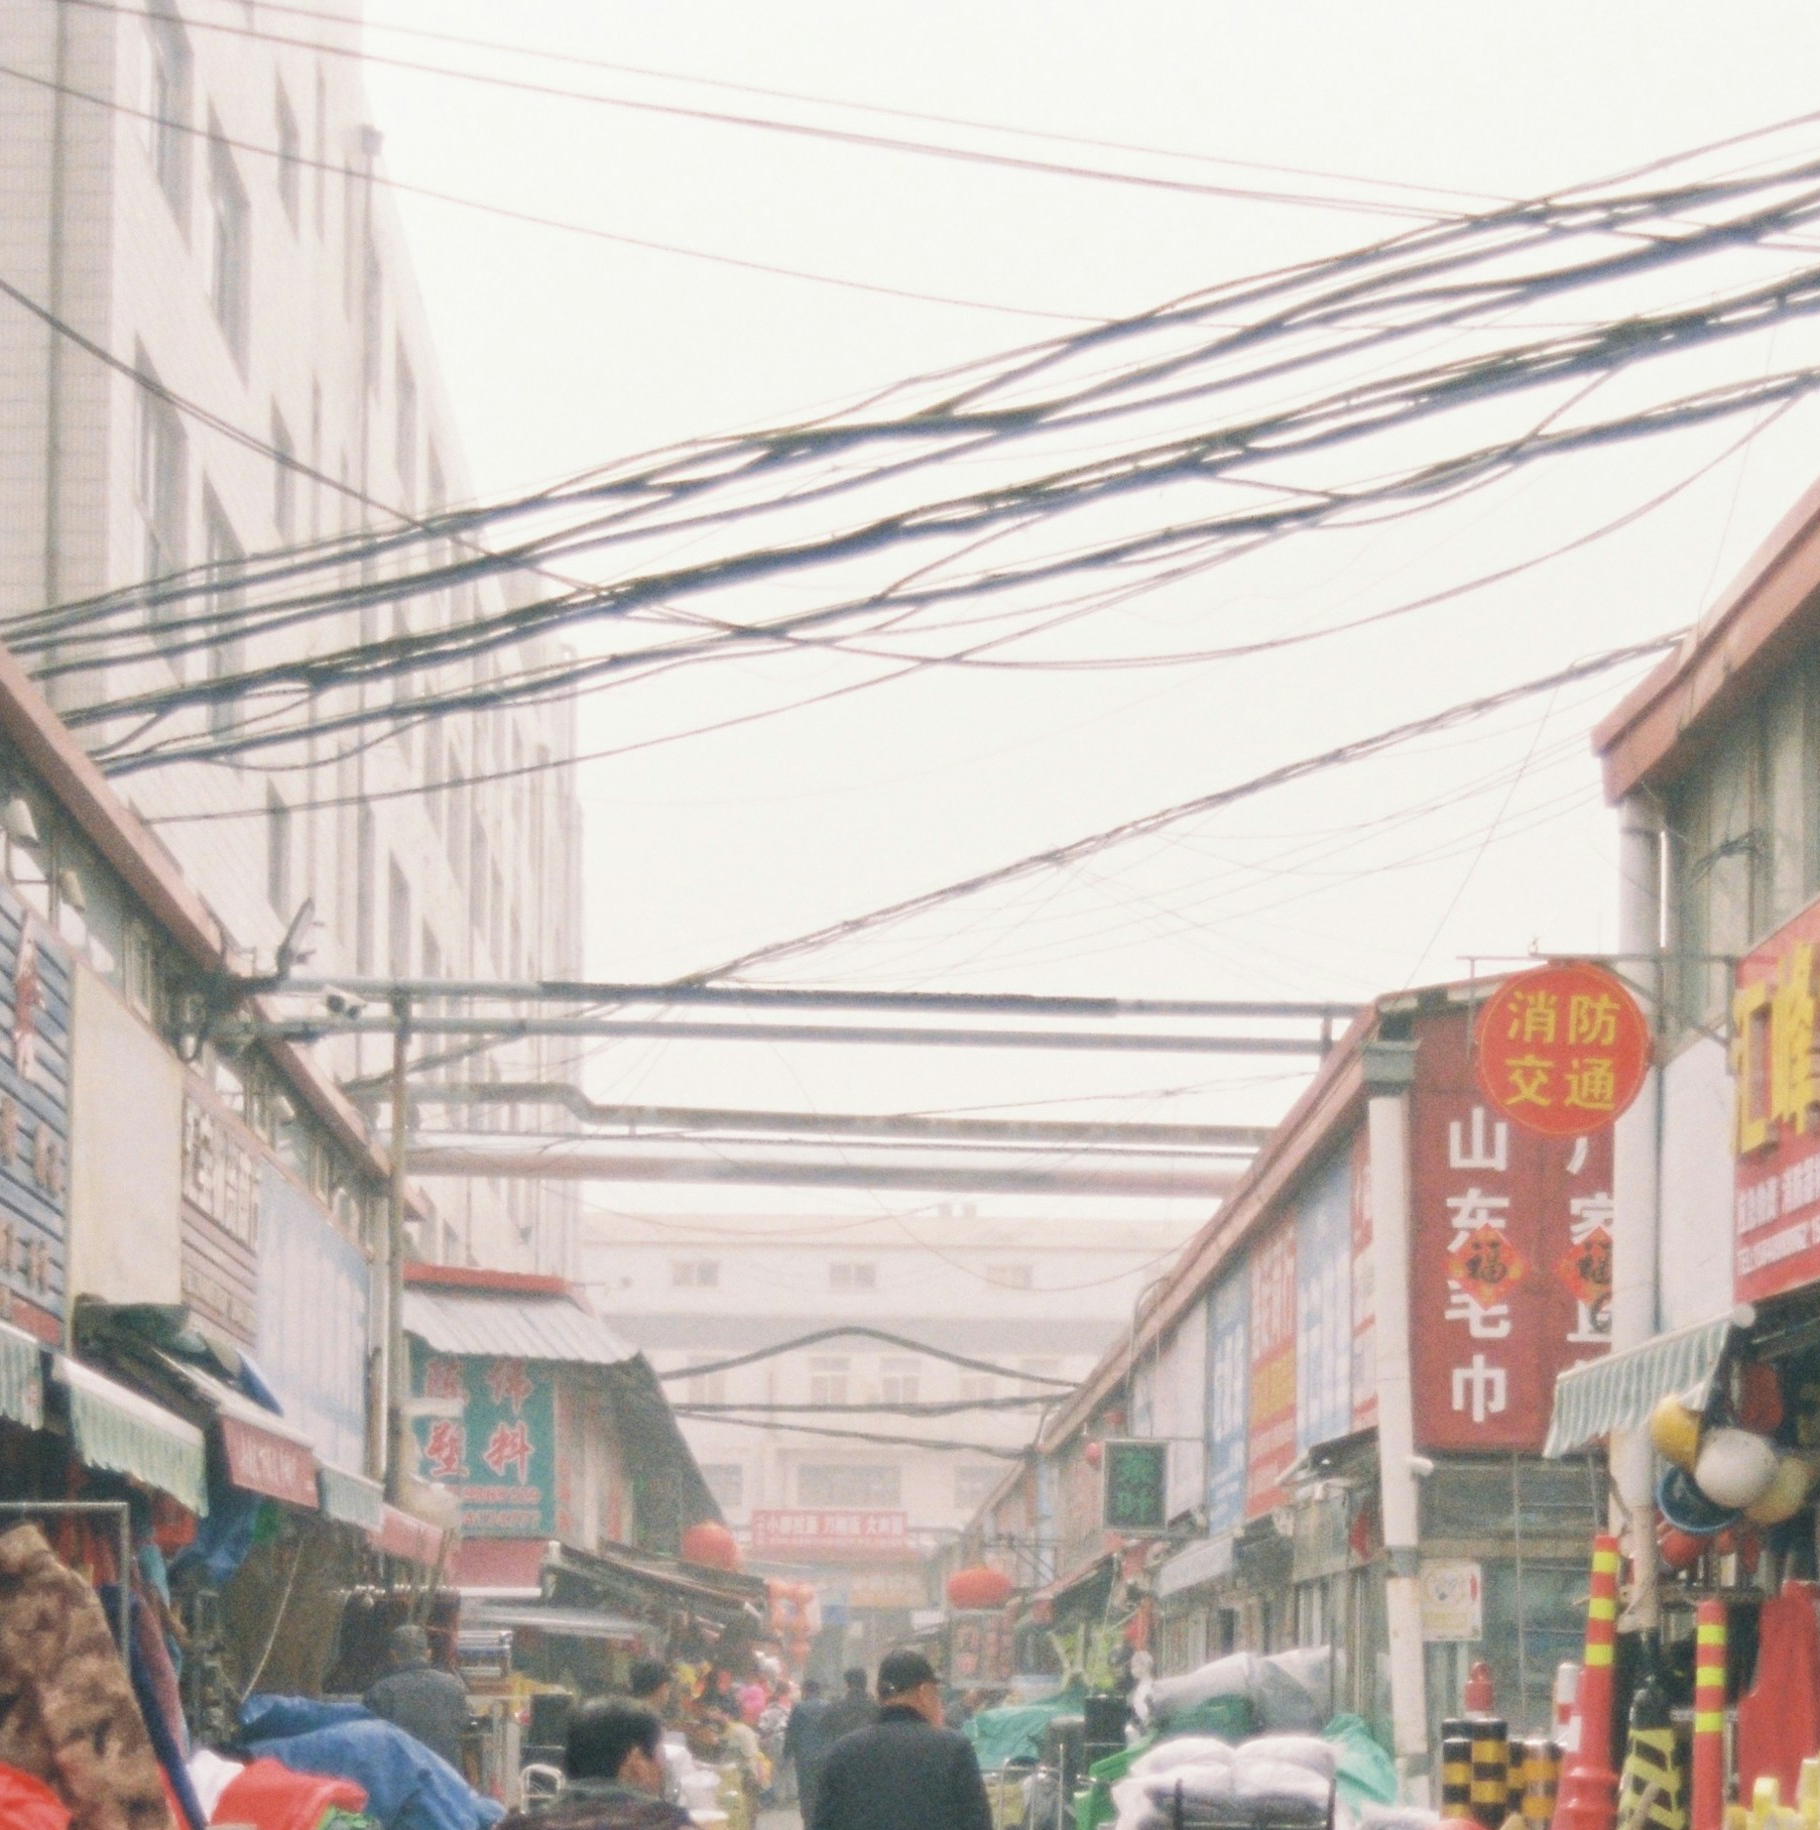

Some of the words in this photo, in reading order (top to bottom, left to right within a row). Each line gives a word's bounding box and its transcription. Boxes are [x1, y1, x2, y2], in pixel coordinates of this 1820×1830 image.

[1505, 990, 1621, 1045] 消防
[1503, 1054, 1616, 1111] 交通
[1443, 1106, 1513, 1424] 山东毛巾
[1465, 1236, 1510, 1286] 福
